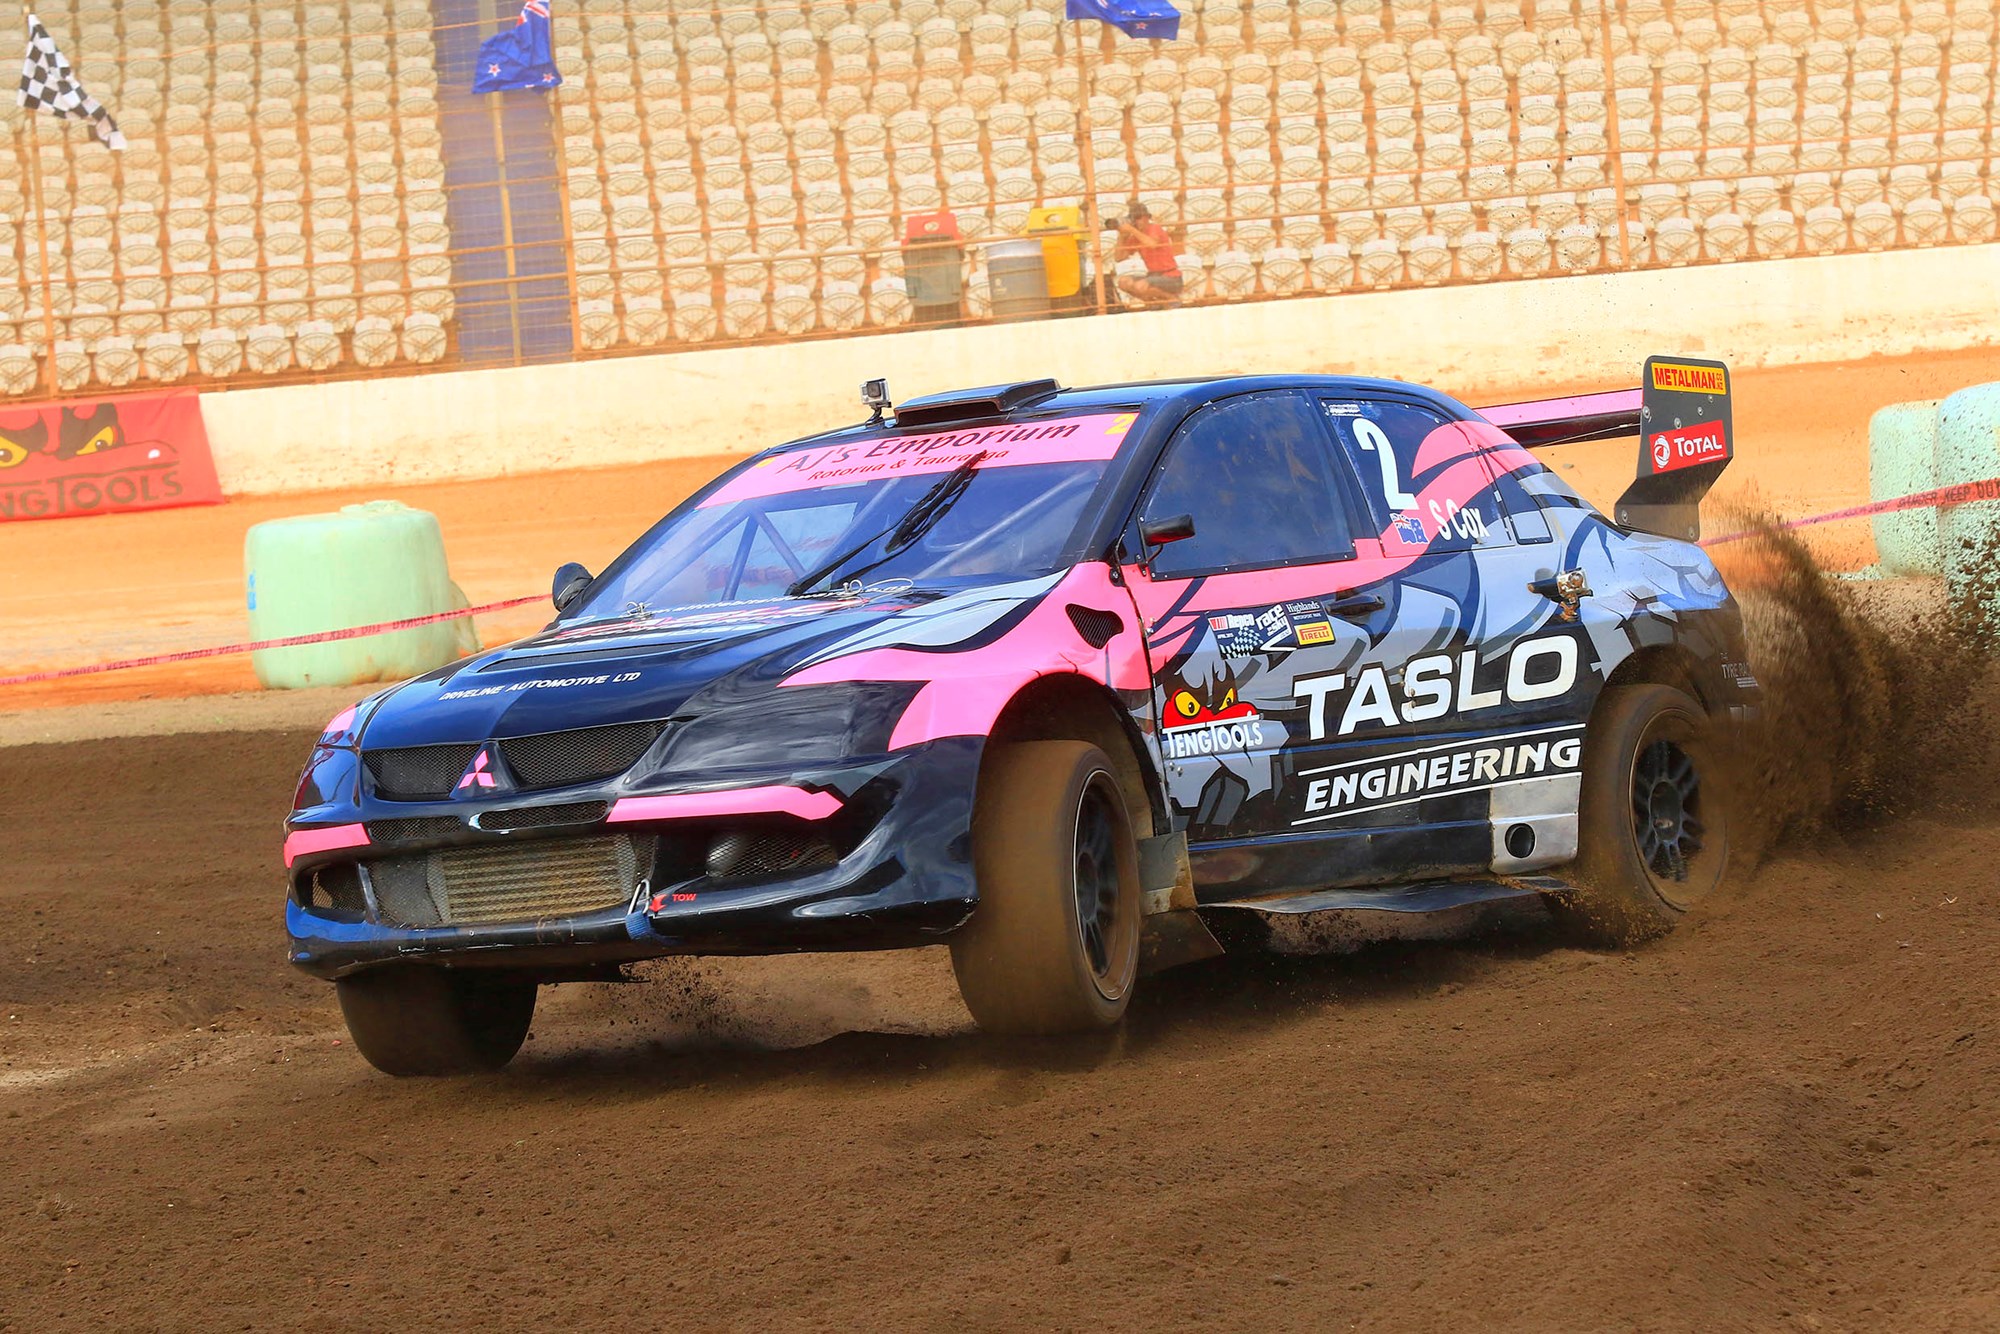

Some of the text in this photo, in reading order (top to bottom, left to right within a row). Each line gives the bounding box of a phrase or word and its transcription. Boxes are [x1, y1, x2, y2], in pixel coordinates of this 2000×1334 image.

[1654, 367, 1716, 390] METALMAN
[1104, 413, 1136, 435] 2
[865, 424, 1081, 456] Emporium
[1674, 434, 1723, 457] TOTAL
[807, 450, 1010, 481] Rotorua & Tauraga
[1352, 417, 1420, 510] 2
[1428, 498, 1451, 541] S
[1255, 604, 1285, 630] race
[1285, 600, 1321, 614] Highlands
[1299, 625, 1331, 640] PIRELLI
[438, 671, 642, 701] DRIVELINE AUTOMOTIVE LTD
[1292, 634, 1578, 741] TASLO
[1304, 737, 1582, 813] ENGINEERING
[672, 893, 697, 902] TOW
